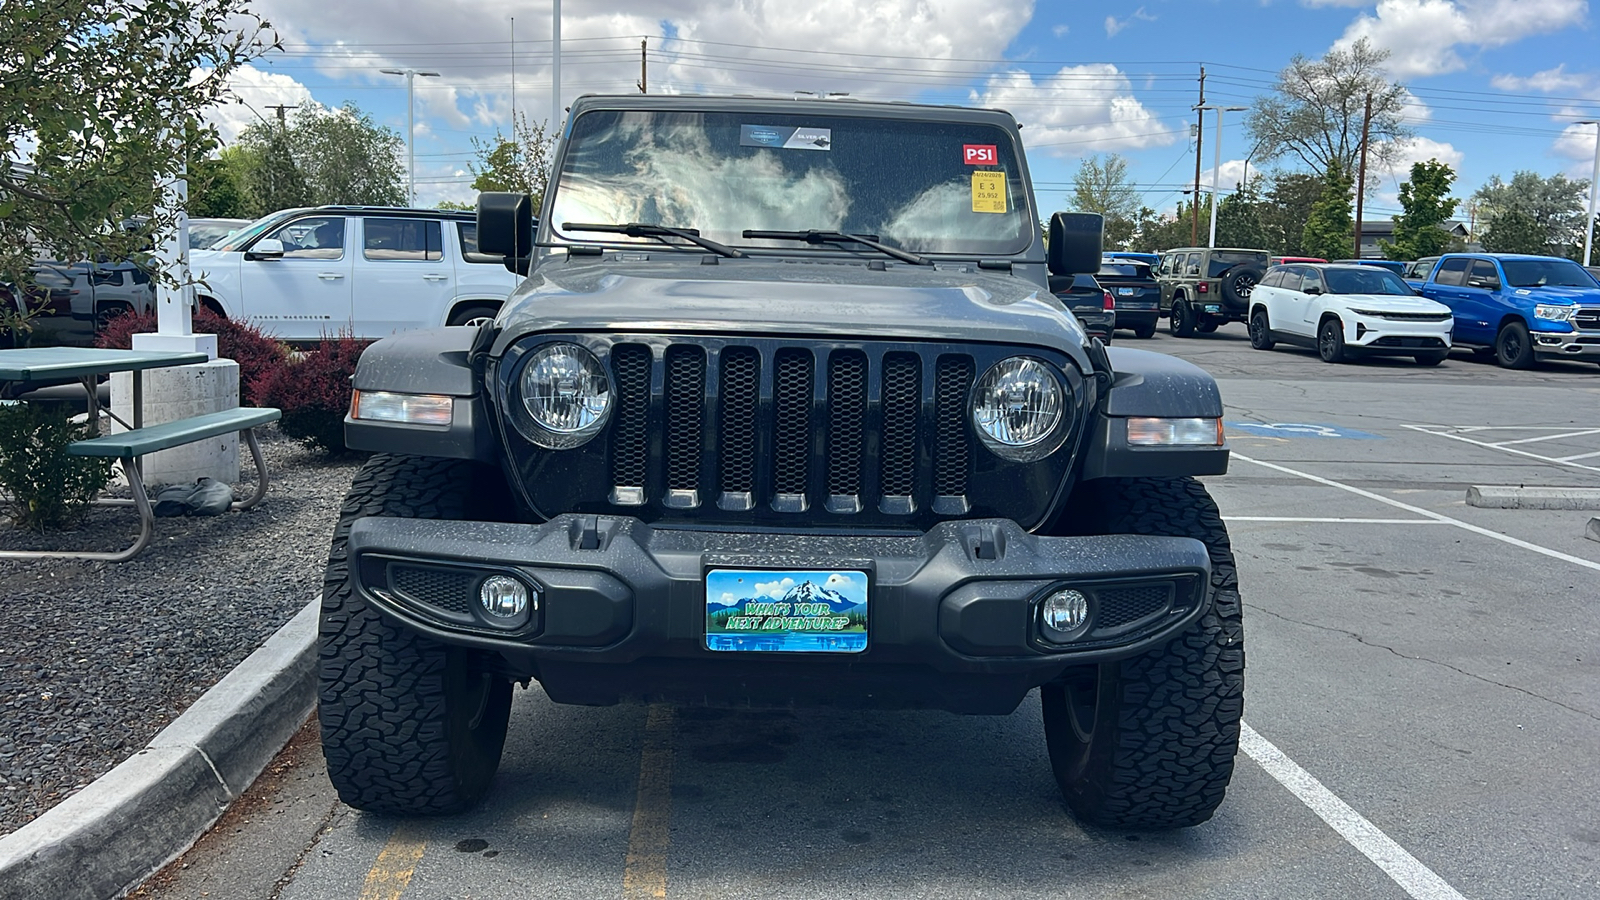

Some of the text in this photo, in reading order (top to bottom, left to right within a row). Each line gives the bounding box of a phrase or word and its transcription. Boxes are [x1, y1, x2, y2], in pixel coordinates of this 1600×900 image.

[966, 148, 993, 161] PSI
[744, 602, 831, 616] WHAT'S YOUR
[725, 616, 849, 630] NEXT ADVENTURE?
